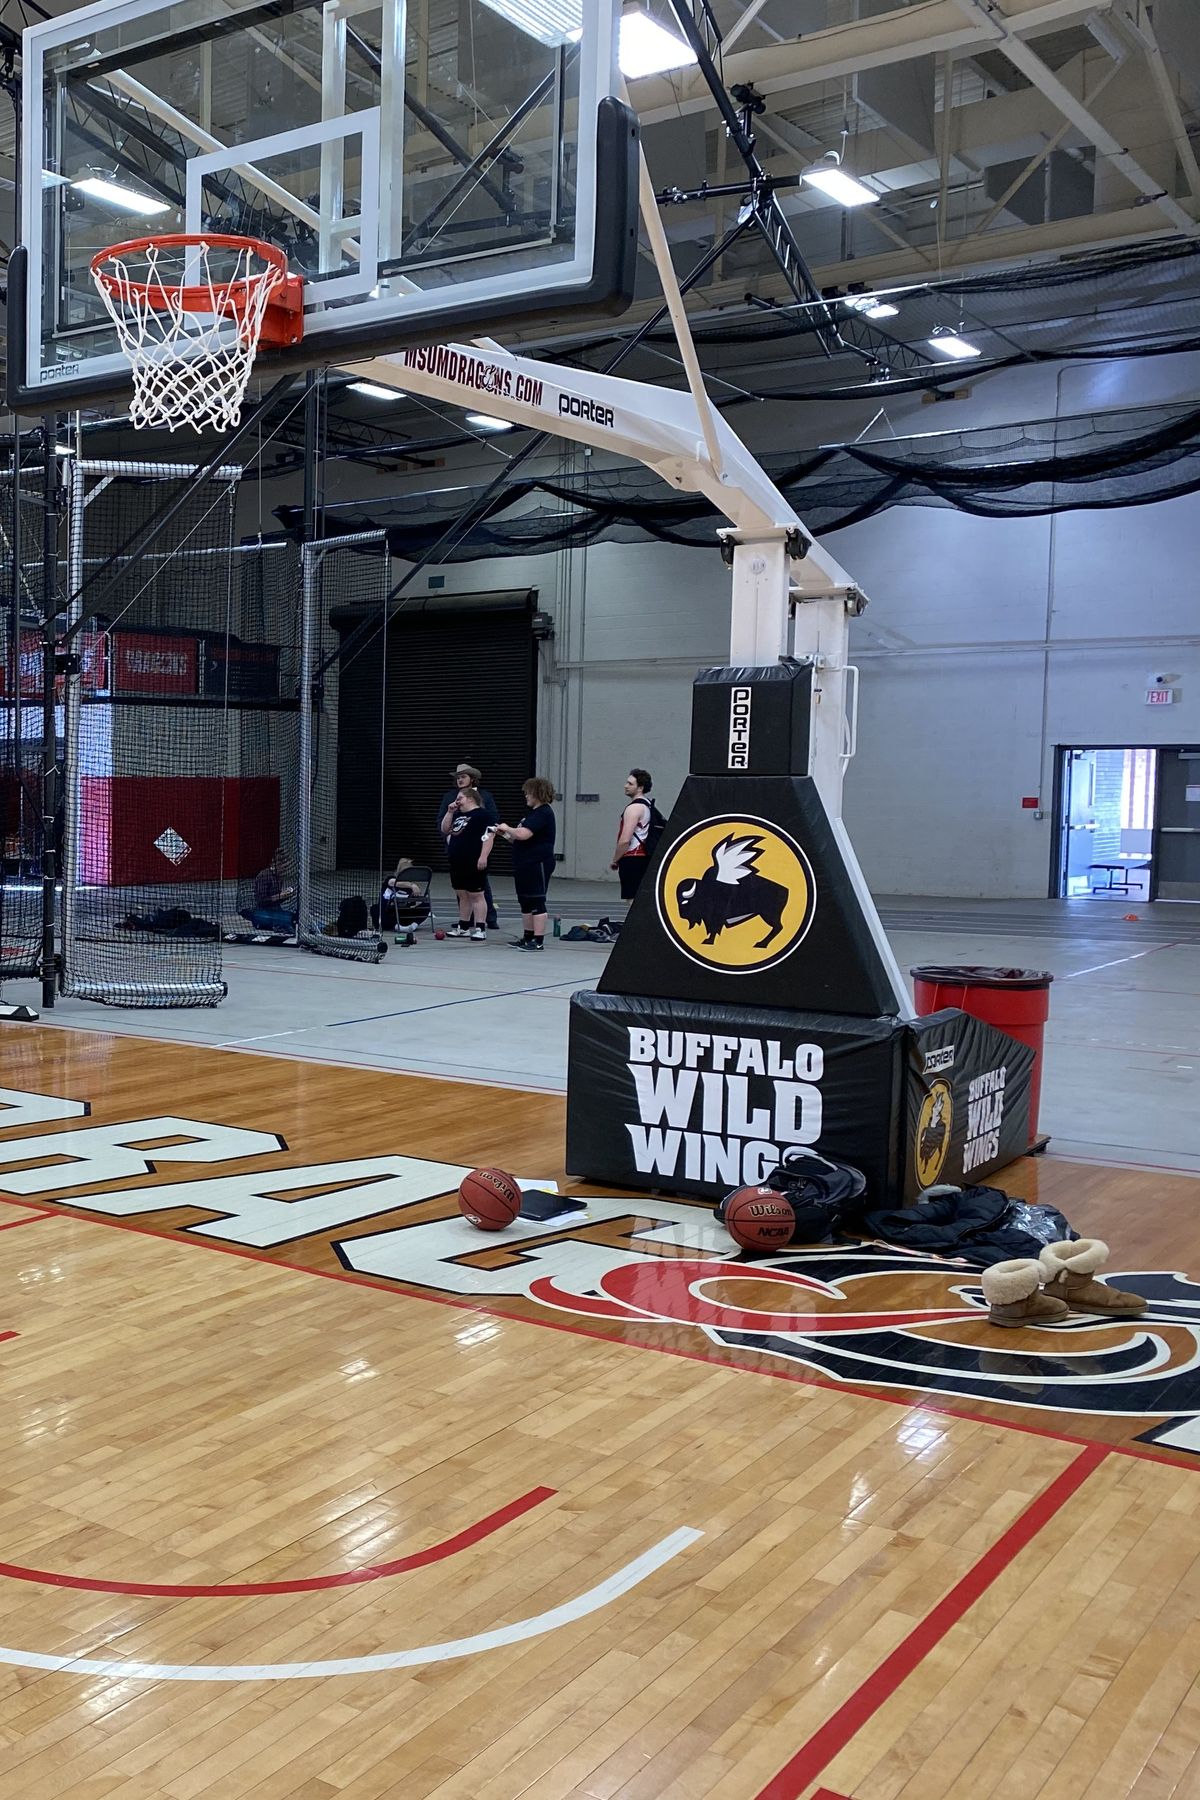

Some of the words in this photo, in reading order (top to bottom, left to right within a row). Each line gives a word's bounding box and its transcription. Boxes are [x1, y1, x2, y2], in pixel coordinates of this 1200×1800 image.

[404, 346, 543, 406] MSUMDRAGNS.COM
[1150, 690, 1168, 703] EXIT
[627, 1026, 824, 1082] BUFFALO
[626, 1063, 822, 1145] WILD
[968, 1066, 1007, 1102] BUFFALO
[966, 1090, 1005, 1141] WILD
[624, 1123, 818, 1187] WING
[962, 1128, 1000, 1175] WINGS
[479, 1171, 515, 1202] Wilson
[749, 1204, 793, 1217] Wilson
[757, 1227, 790, 1238] NCAA
